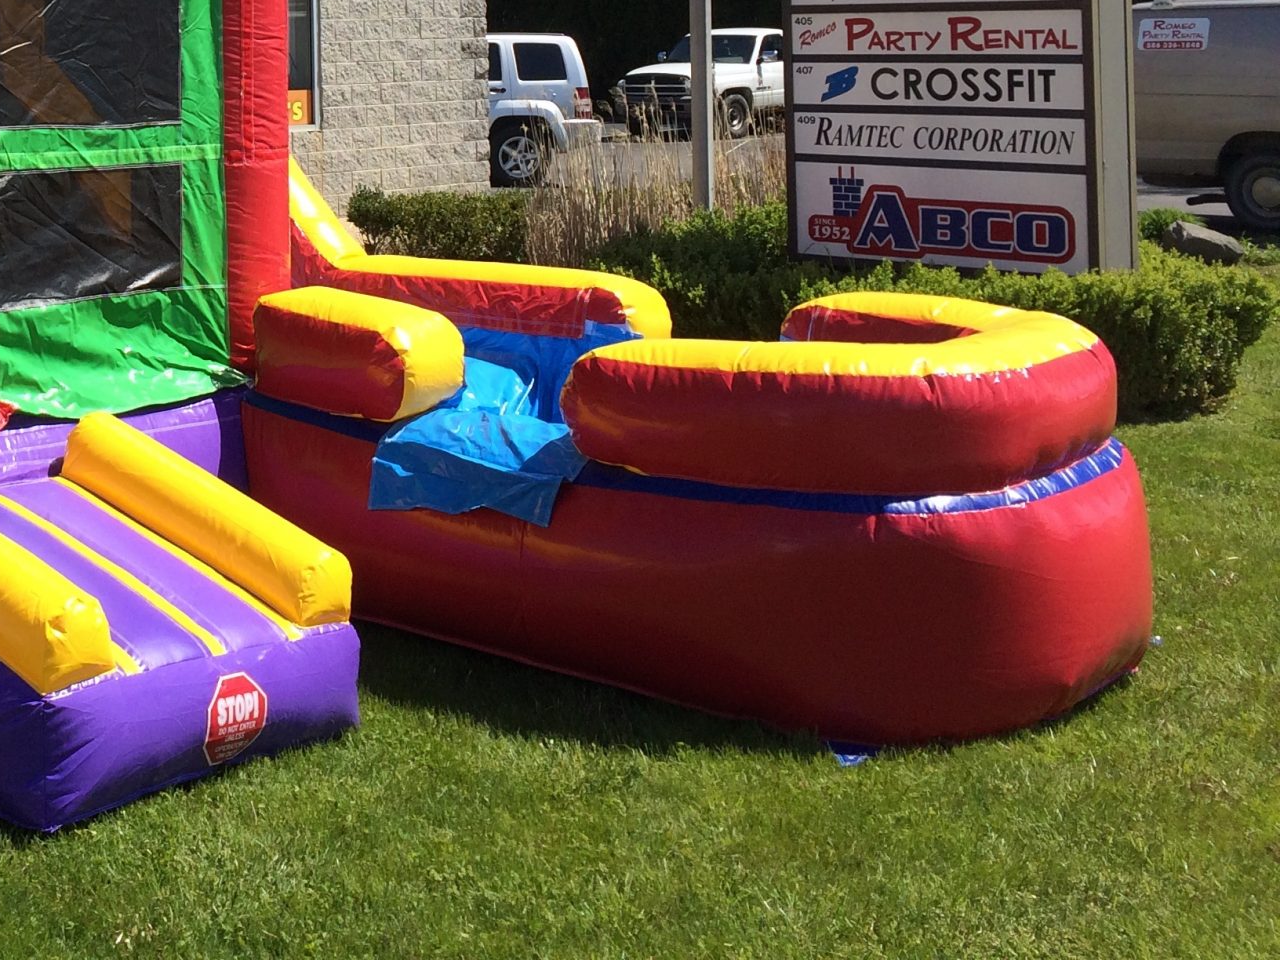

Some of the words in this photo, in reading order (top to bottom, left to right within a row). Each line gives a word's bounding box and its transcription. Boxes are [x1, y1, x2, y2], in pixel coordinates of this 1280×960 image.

[794, 16, 813, 26] 405
[799, 21, 837, 49] Romeo
[845, 17, 942, 51] PARTY
[947, 16, 1078, 51] RENTAL
[795, 66, 813, 75] 407
[871, 67, 1056, 103] CROSSFIT
[797, 115, 816, 125] 409
[815, 116, 905, 150] RAMTEC
[913, 126, 1075, 156] CORPORATION
[813, 225, 851, 240] 1952
[854, 191, 1068, 256] ABCO
